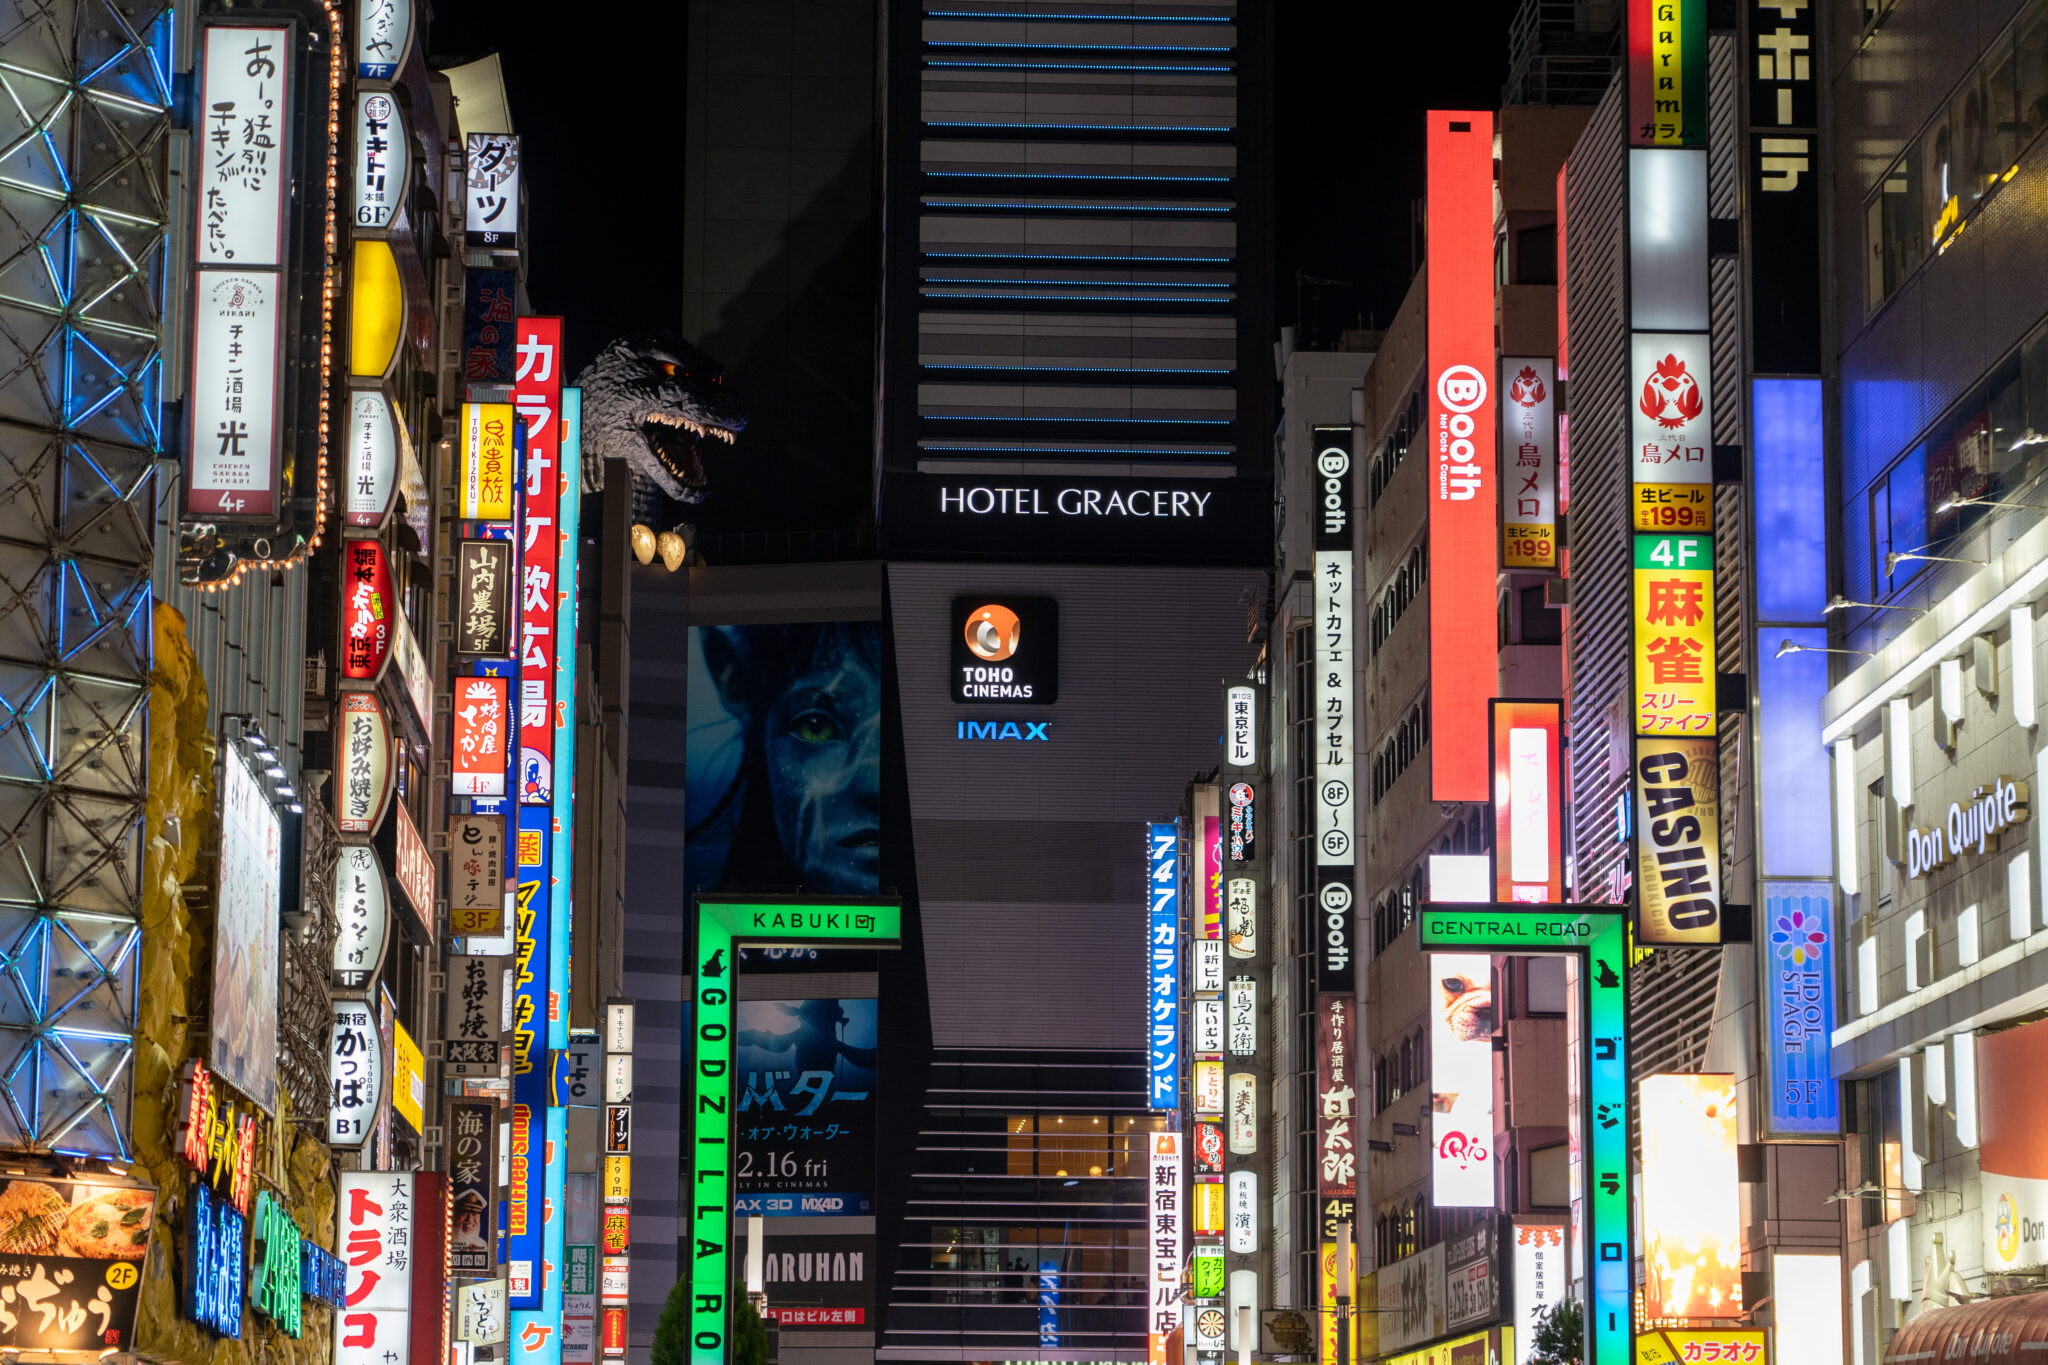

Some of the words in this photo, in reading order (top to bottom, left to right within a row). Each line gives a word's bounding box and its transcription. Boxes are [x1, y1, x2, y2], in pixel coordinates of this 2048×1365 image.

[366, 65, 387, 77] 7F
[1640, 123, 1695, 139] ガラム
[476, 140, 512, 224] ダーツ
[357, 206, 391, 224] 6F
[484, 231, 499, 243] 8F
[225, 324, 244, 414] チキン酒場
[217, 420, 248, 456] 光
[1437, 364, 1487, 501] Booth
[1658, 434, 1686, 442] 三代目
[361, 422, 373, 472] チキン酒場
[470, 418, 479, 499] TORIKIZOKU
[1640, 443, 1705, 464] 鳥メロ
[482, 419, 505, 504] 鳥貴族
[357, 475, 375, 495] 光
[1318, 447, 1350, 534] Booth
[1516, 442, 1542, 517] 鳥メロ
[218, 490, 245, 513] 4F
[940, 487, 1049, 515] HOTEL
[1057, 488, 1212, 517] GRACERY
[1641, 488, 1705, 504] 生ビール
[357, 513, 371, 525] 4F
[1507, 528, 1550, 538] 生ビール
[1513, 539, 1551, 557] 199
[1650, 539, 1698, 567] 4F
[465, 546, 498, 639] 山内農場
[376, 624, 386, 655] 3F
[473, 638, 490, 651] 5F
[1646, 577, 1705, 685] 麻雀
[963, 667, 1013, 683] TOHO
[963, 684, 1033, 698] CINEMAS
[1641, 693, 1695, 711] スリー
[478, 700, 501, 755] 焼肉屋
[957, 721, 1049, 741] IMAX
[1234, 701, 1249, 759] 東京ビル
[1641, 713, 1714, 732] ファイブ
[458, 704, 480, 769] さかい
[350, 715, 374, 818] お好み焼き
[466, 776, 490, 793] 4F
[1327, 787, 1344, 800] 8F
[341, 820, 369, 832] 2階
[1908, 827, 1943, 880] Don
[1948, 777, 2017, 855] Quijote
[1327, 837, 1344, 849] 5F
[1640, 752, 1717, 931] CASINO
[1641, 854, 1668, 937] KABUKICHO
[348, 874, 369, 965] とらそば
[463, 911, 490, 929] 3F
[1320, 881, 1352, 971] Booth
[1431, 921, 1528, 936] CENTRAL
[1535, 922, 1591, 937] ROAD
[341, 972, 365, 985] 1F
[1204, 942, 1219, 989] 川新ビル
[458, 958, 489, 1039] お好み焼
[1782, 971, 1803, 1053] STAGE
[1802, 971, 1822, 1040] IDOL
[337, 1013, 367, 1026] 新宿
[1330, 1000, 1345, 1082] 手作り居酒屋
[334, 1028, 367, 1109] かっぱ
[1785, 1079, 1823, 1104] 5F
[336, 1119, 361, 1135] B1
[616, 1108, 628, 1142] ダーツ
[695, 988, 727, 1260] GODZILLA
[1320, 1086, 1356, 1185] 甘太郎
[456, 1110, 484, 1185] 海の家
[1203, 1124, 1221, 1164] おすすめ
[737, 1151, 797, 1178] 2.16
[804, 1159, 827, 1177] fri
[1200, 1164, 1209, 1172] 7F
[766, 1199, 793, 1211] 3D
[801, 1197, 844, 1212] MX4D
[1324, 1199, 1354, 1218] 4F
[386, 1178, 410, 1272] 大衆酒場
[605, 1215, 627, 1249] 麻雀
[2023, 1217, 2045, 1243] Don
[1155, 1165, 1178, 1333] 新宿東宝ビル店
[111, 1268, 133, 1284] 2F
[1534, 1251, 1544, 1300] 個室居酒屋
[491, 1290, 503, 1299] 2F
[1206, 1351, 1218, 1359] 4F
[1683, 1341, 1762, 1362] カラオケ
